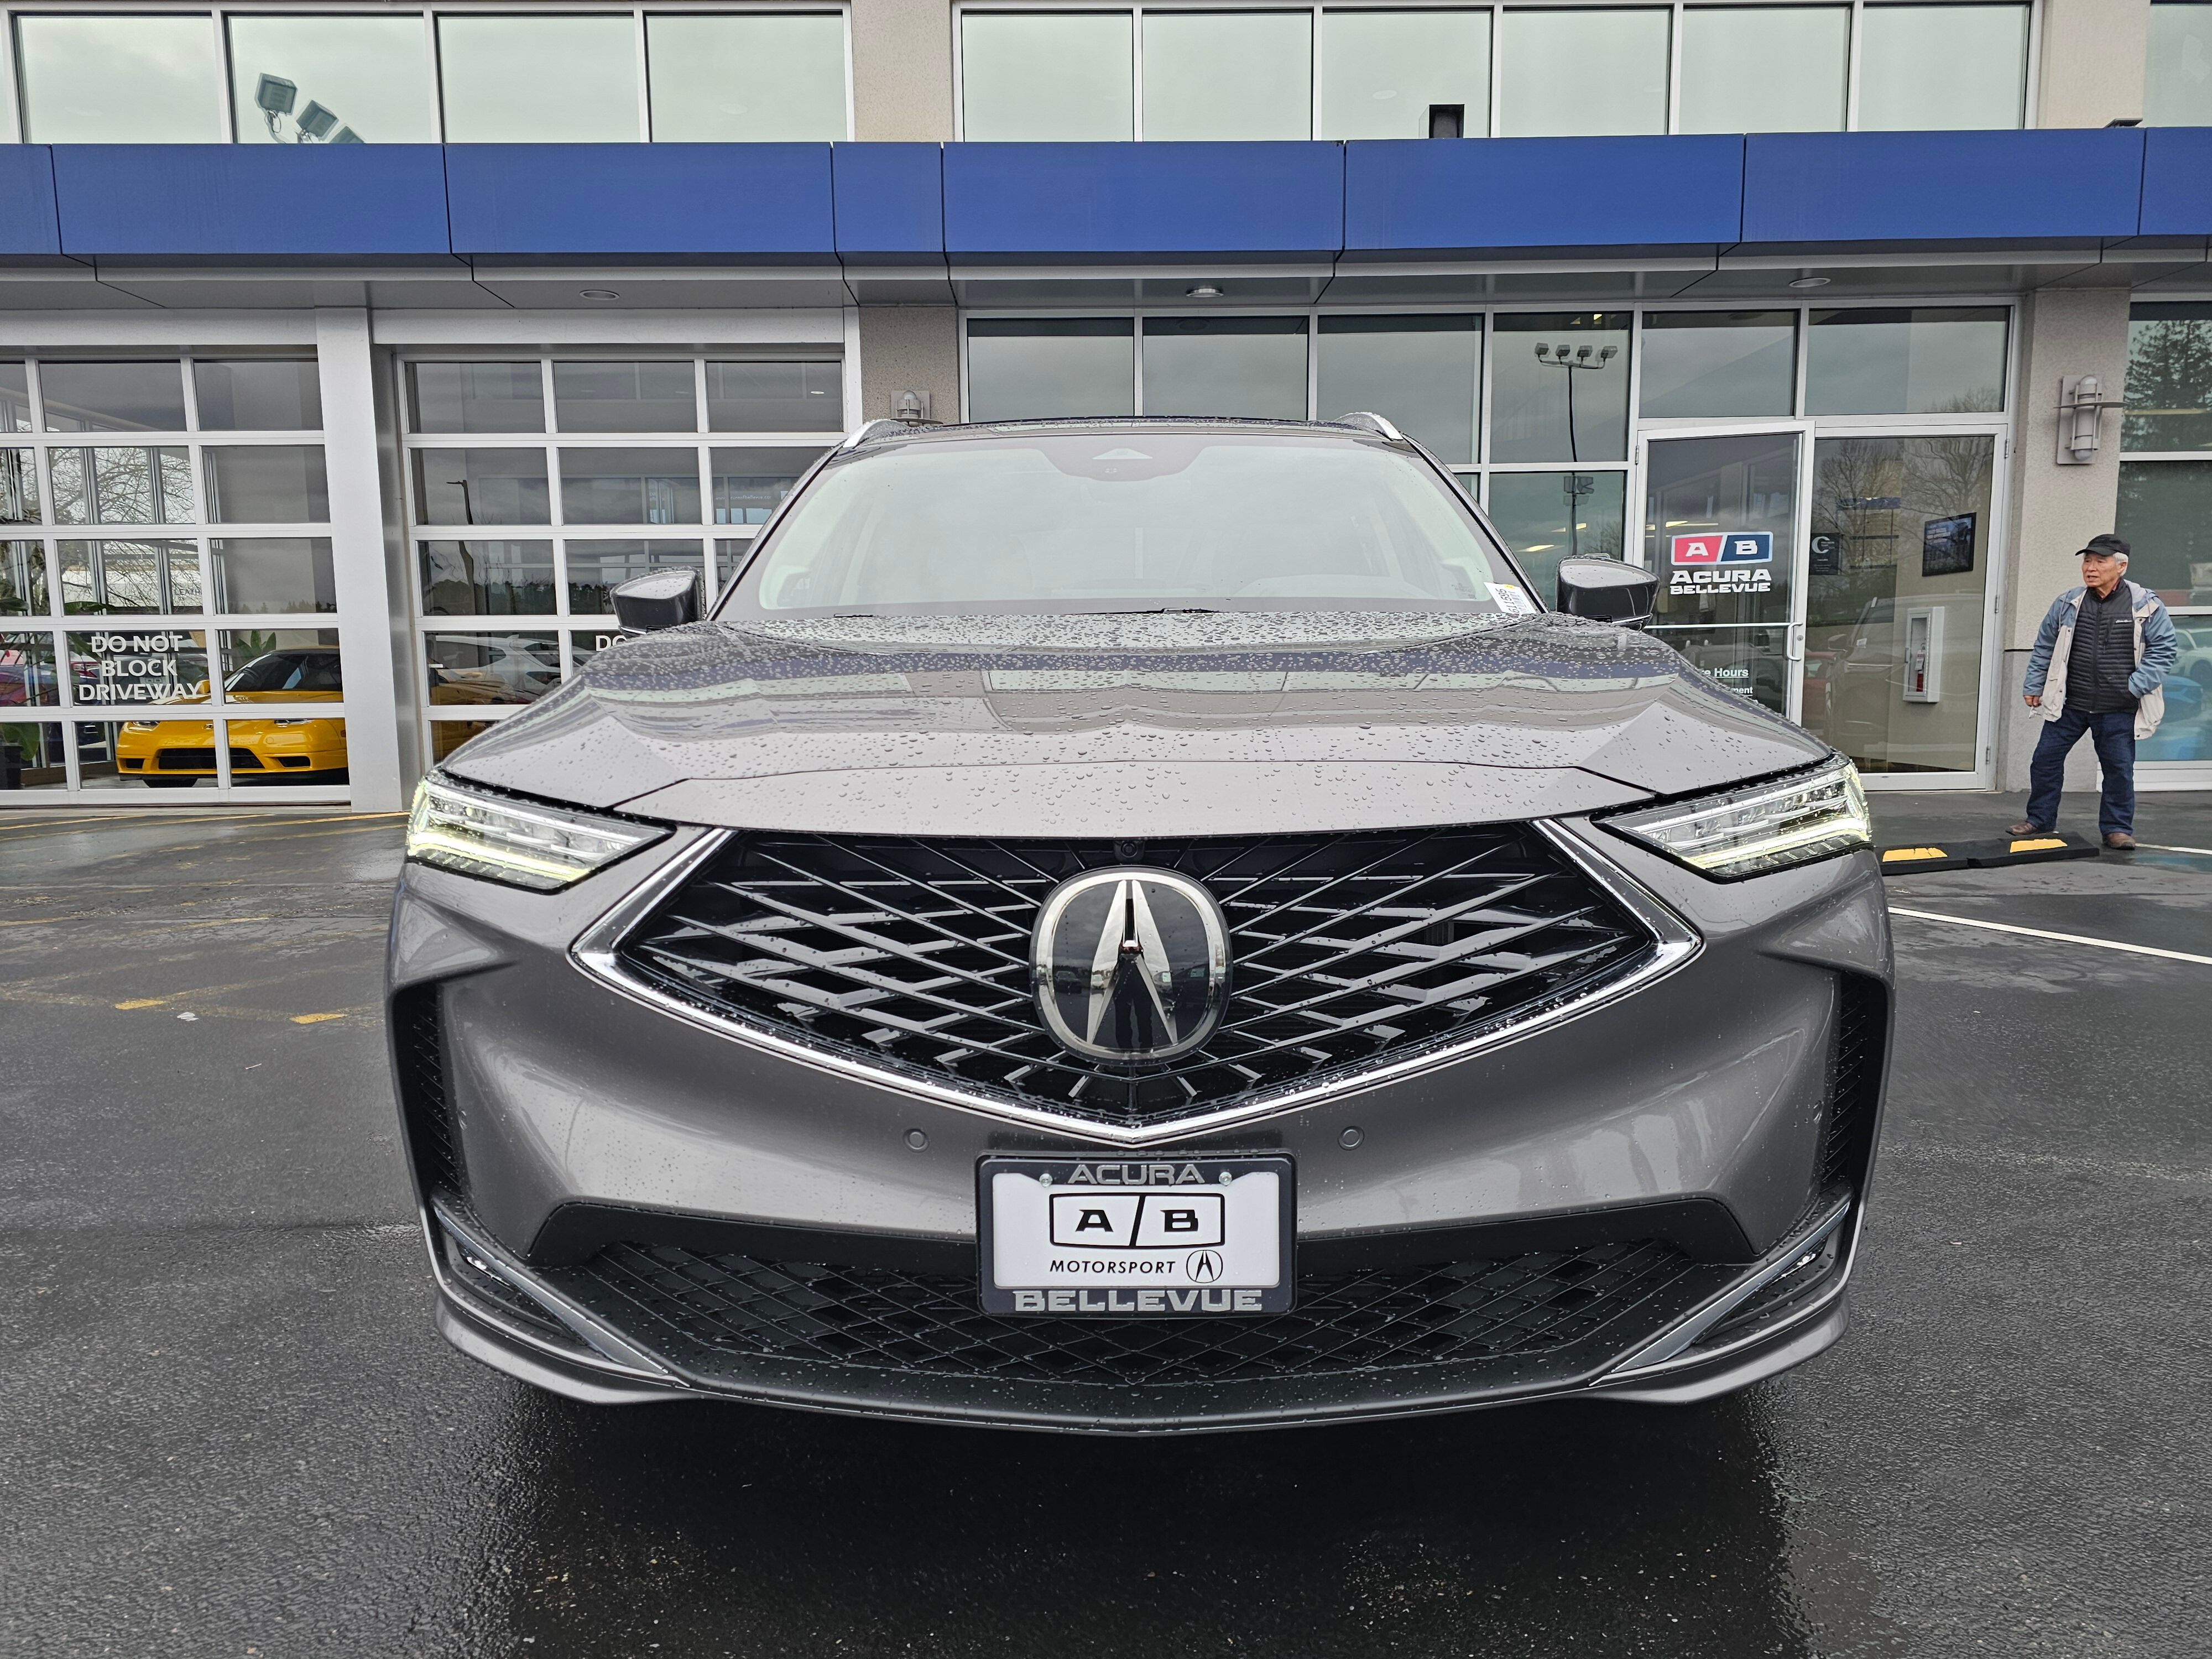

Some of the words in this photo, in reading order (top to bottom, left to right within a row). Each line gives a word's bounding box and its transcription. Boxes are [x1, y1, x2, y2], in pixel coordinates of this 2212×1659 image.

[1686, 542, 1709, 556] A
[1734, 540, 1757, 555] B
[1670, 569, 1772, 584] ACURA
[1670, 582, 1771, 594] BELLEVUE
[91, 635, 127, 653] DO
[133, 635, 183, 652] NOT
[101, 660, 178, 676] BLOCK
[1714, 668, 1749, 677] Hours
[79, 684, 201, 701] DRIVEWAY
[1068, 1164, 1205, 1185] ACURA
[1075, 1209, 1113, 1232] A
[1160, 1209, 1198, 1232] B
[1050, 1260, 1176, 1274] MOTORSPORT
[1013, 1290, 1262, 1312] BELLEVUE
